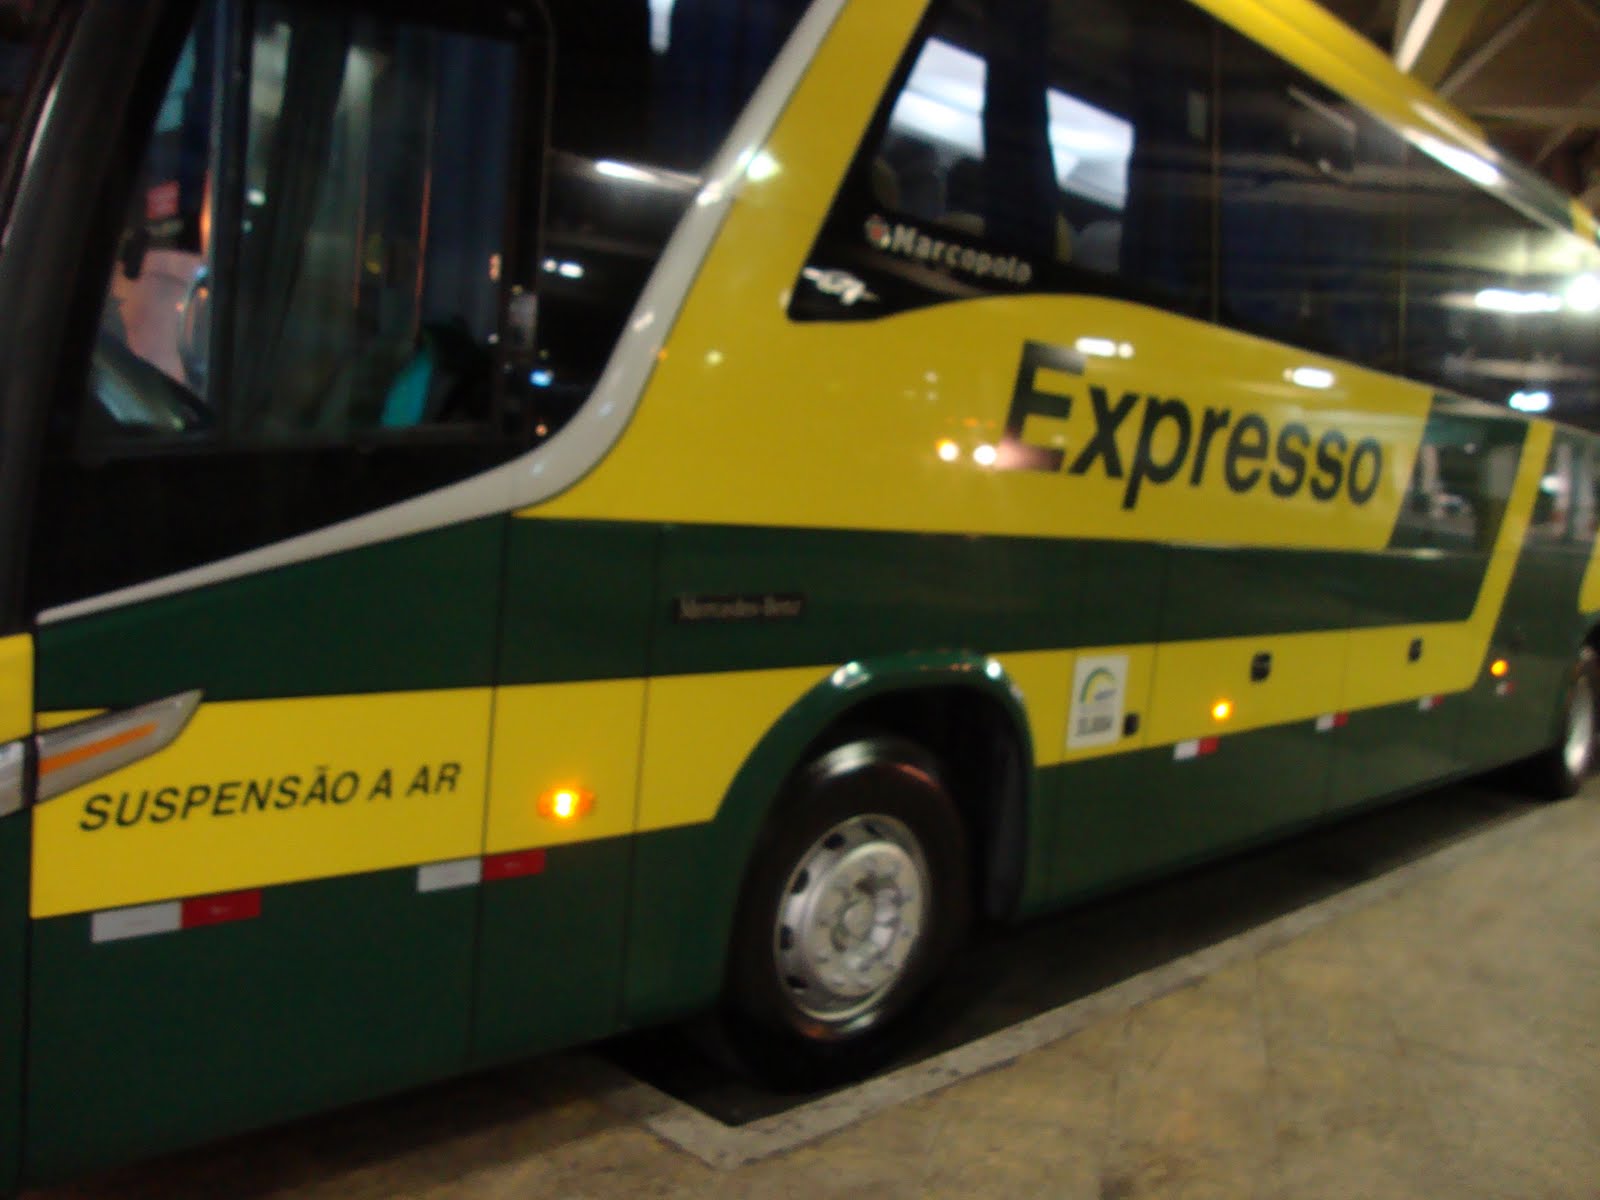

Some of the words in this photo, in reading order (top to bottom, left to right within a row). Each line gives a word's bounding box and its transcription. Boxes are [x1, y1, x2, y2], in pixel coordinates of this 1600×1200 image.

[1003, 339, 1383, 511] Expresso
[79, 764, 361, 832] SUSPENSÃO
[368, 768, 394, 801] A
[405, 762, 462, 796] AR
